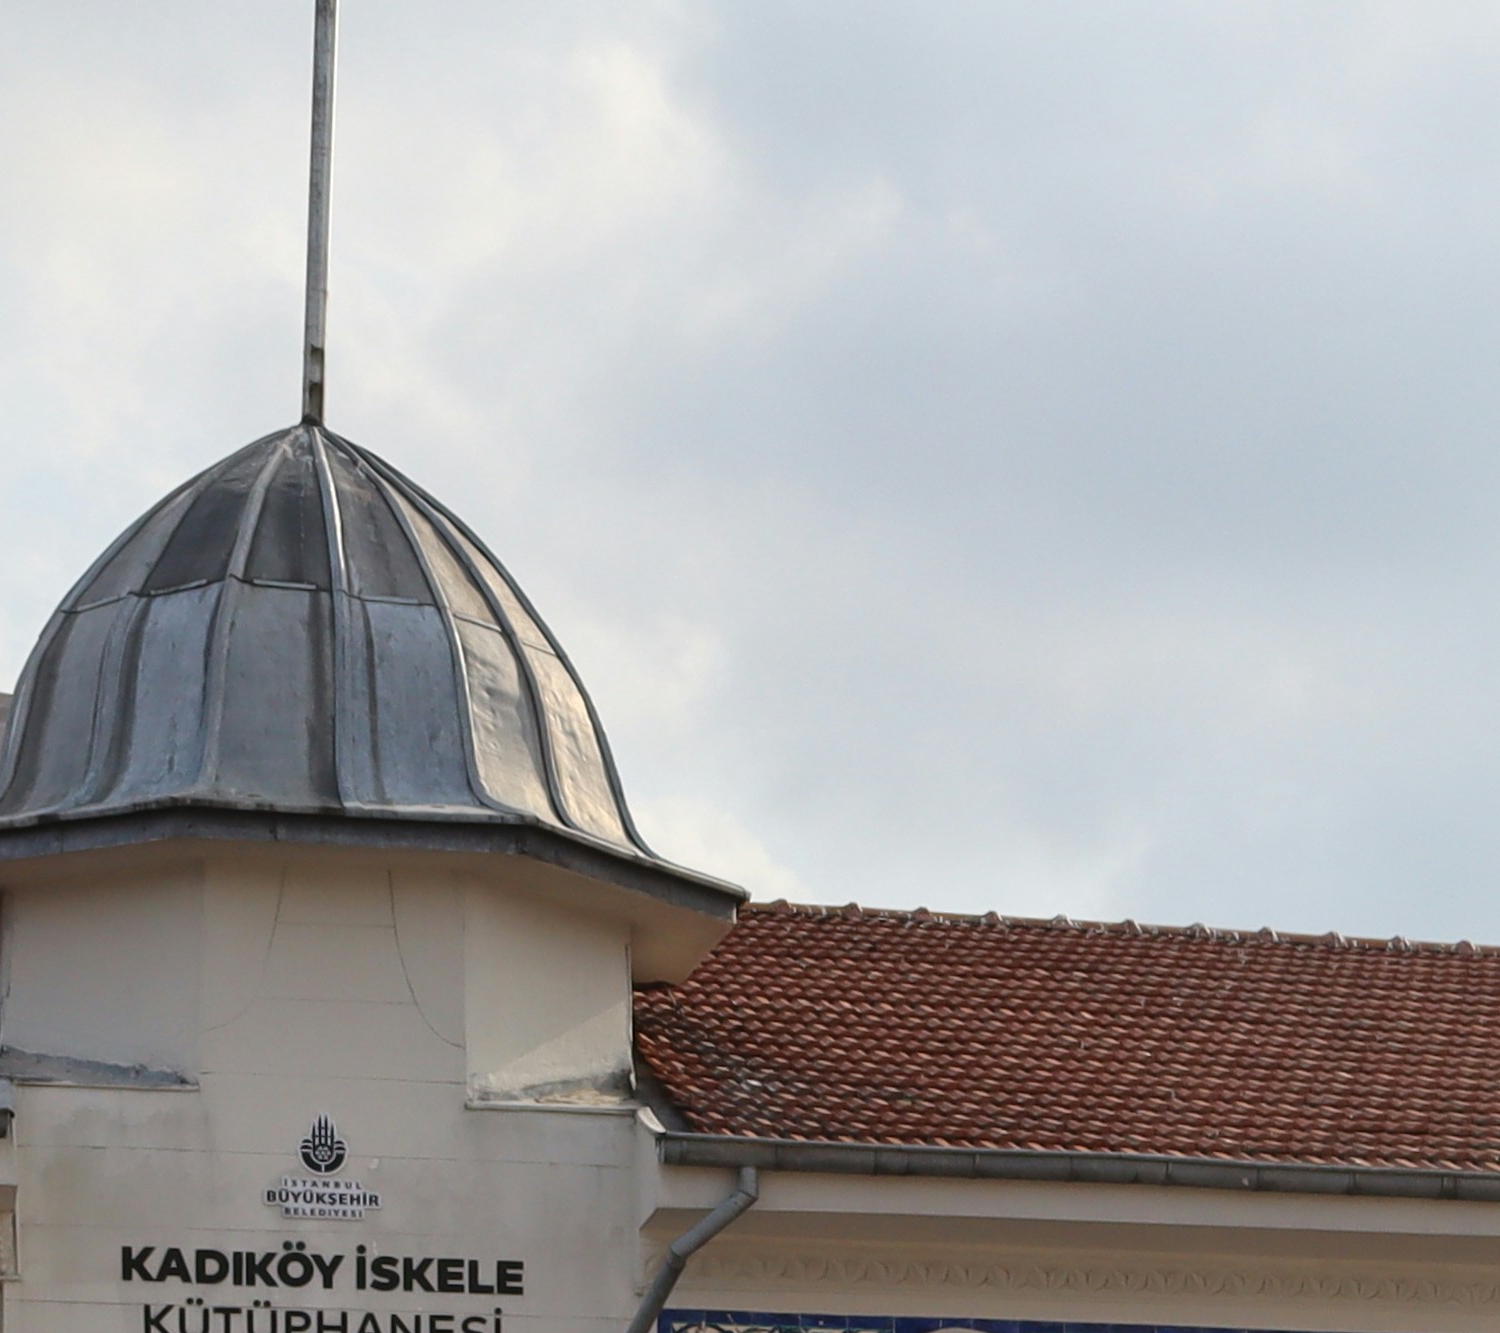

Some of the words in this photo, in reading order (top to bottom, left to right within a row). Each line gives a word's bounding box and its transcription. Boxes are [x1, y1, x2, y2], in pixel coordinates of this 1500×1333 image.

[266, 1188, 380, 1207] BÜYÜKŞEHİR
[120, 1240, 344, 1290] KADIKÖY
[355, 1243, 524, 1295] İSKELE
